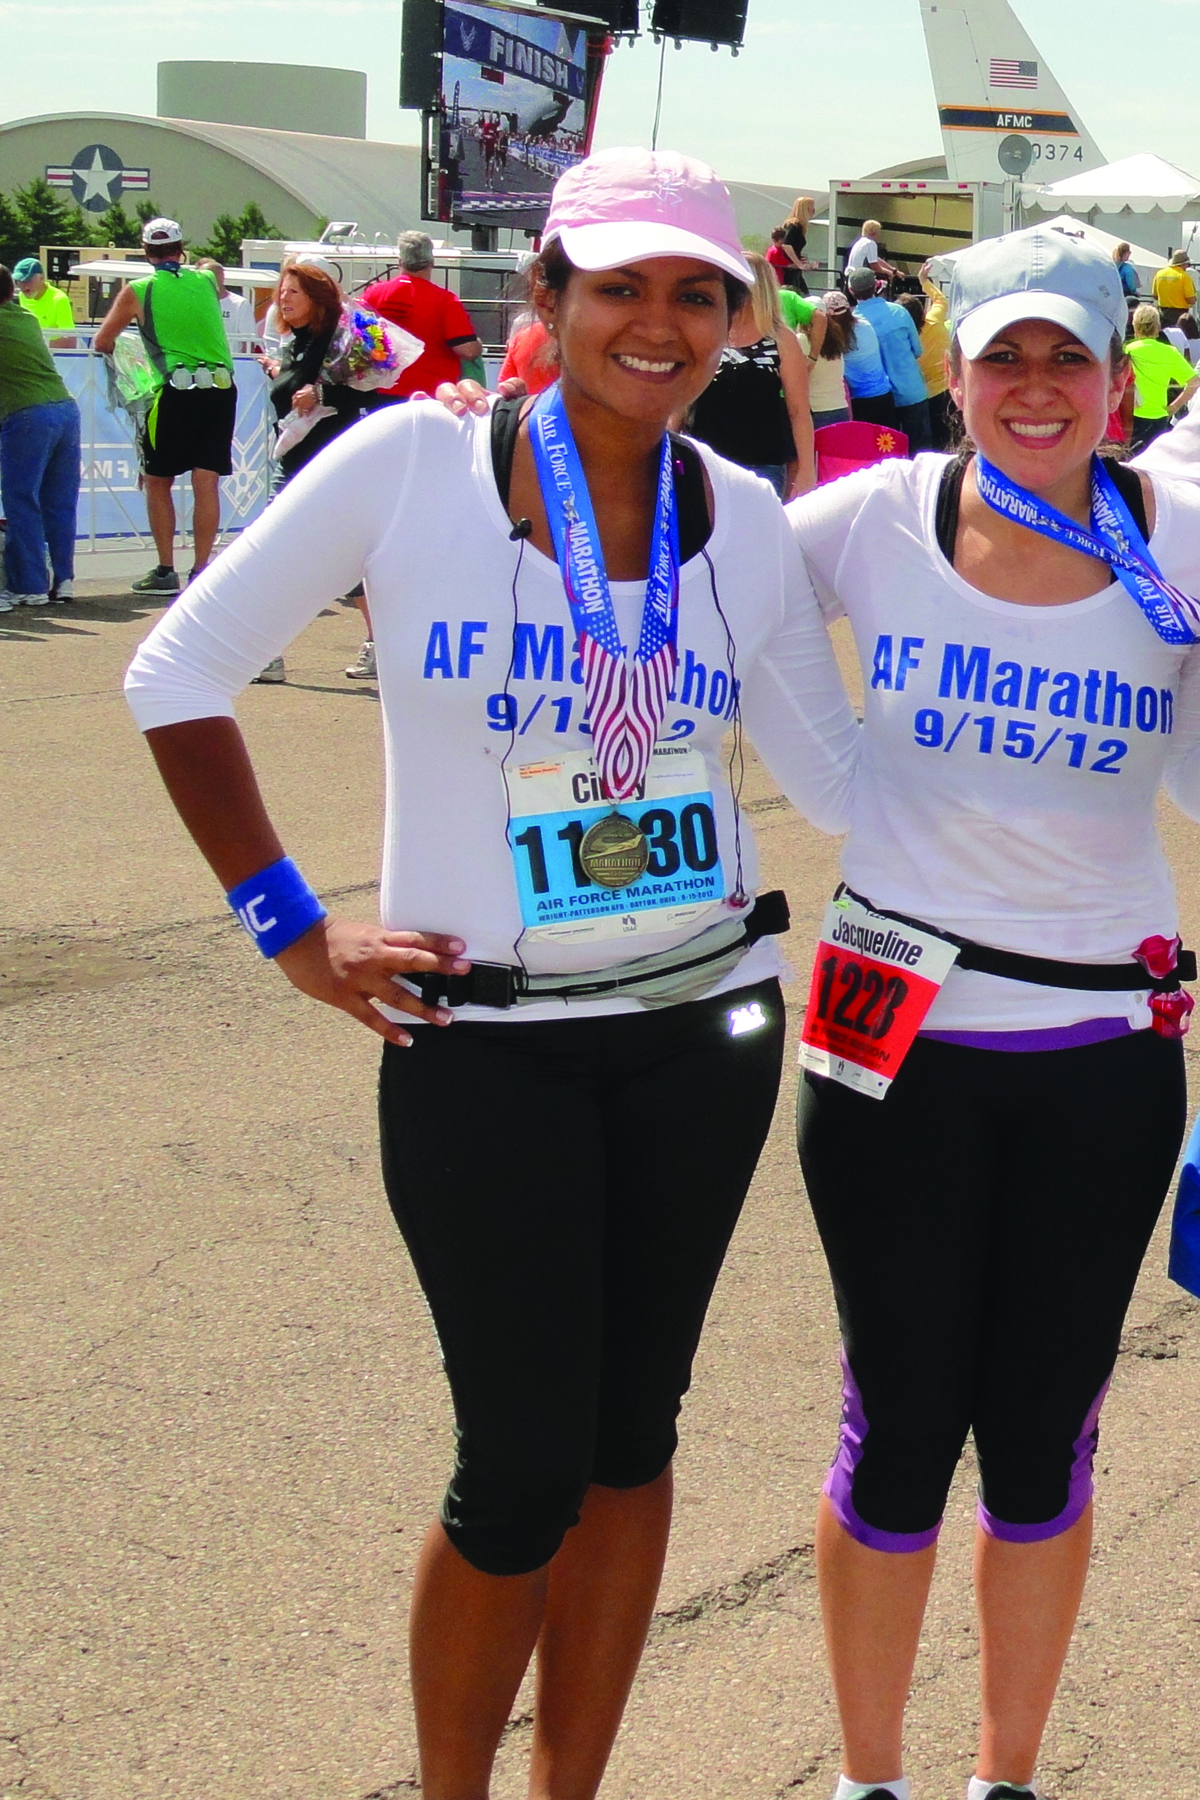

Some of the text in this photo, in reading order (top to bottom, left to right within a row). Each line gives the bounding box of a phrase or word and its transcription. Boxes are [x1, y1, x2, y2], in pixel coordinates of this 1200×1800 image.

[489, 29, 569, 89] FINISH
[996, 114, 1033, 128] AFMC
[542, 413, 573, 493] AIR FORCE
[975, 468, 1038, 527] MARATHON
[569, 520, 605, 614] MARATHON
[1064, 528, 1106, 558] FORCE
[650, 535, 671, 623] AIR FORCE
[1155, 603, 1182, 631] AIR
[422, 620, 742, 723] AF Mahon
[870, 633, 1174, 735] AF Marathon
[913, 707, 1129, 775] 9/15/12
[571, 771, 646, 804] Ciy
[514, 802, 719, 895] 1130
[536, 876, 716, 912] AIR FORCE MARATHON
[832, 914, 924, 967] Jacqueline
[816, 955, 909, 1041] 1223
